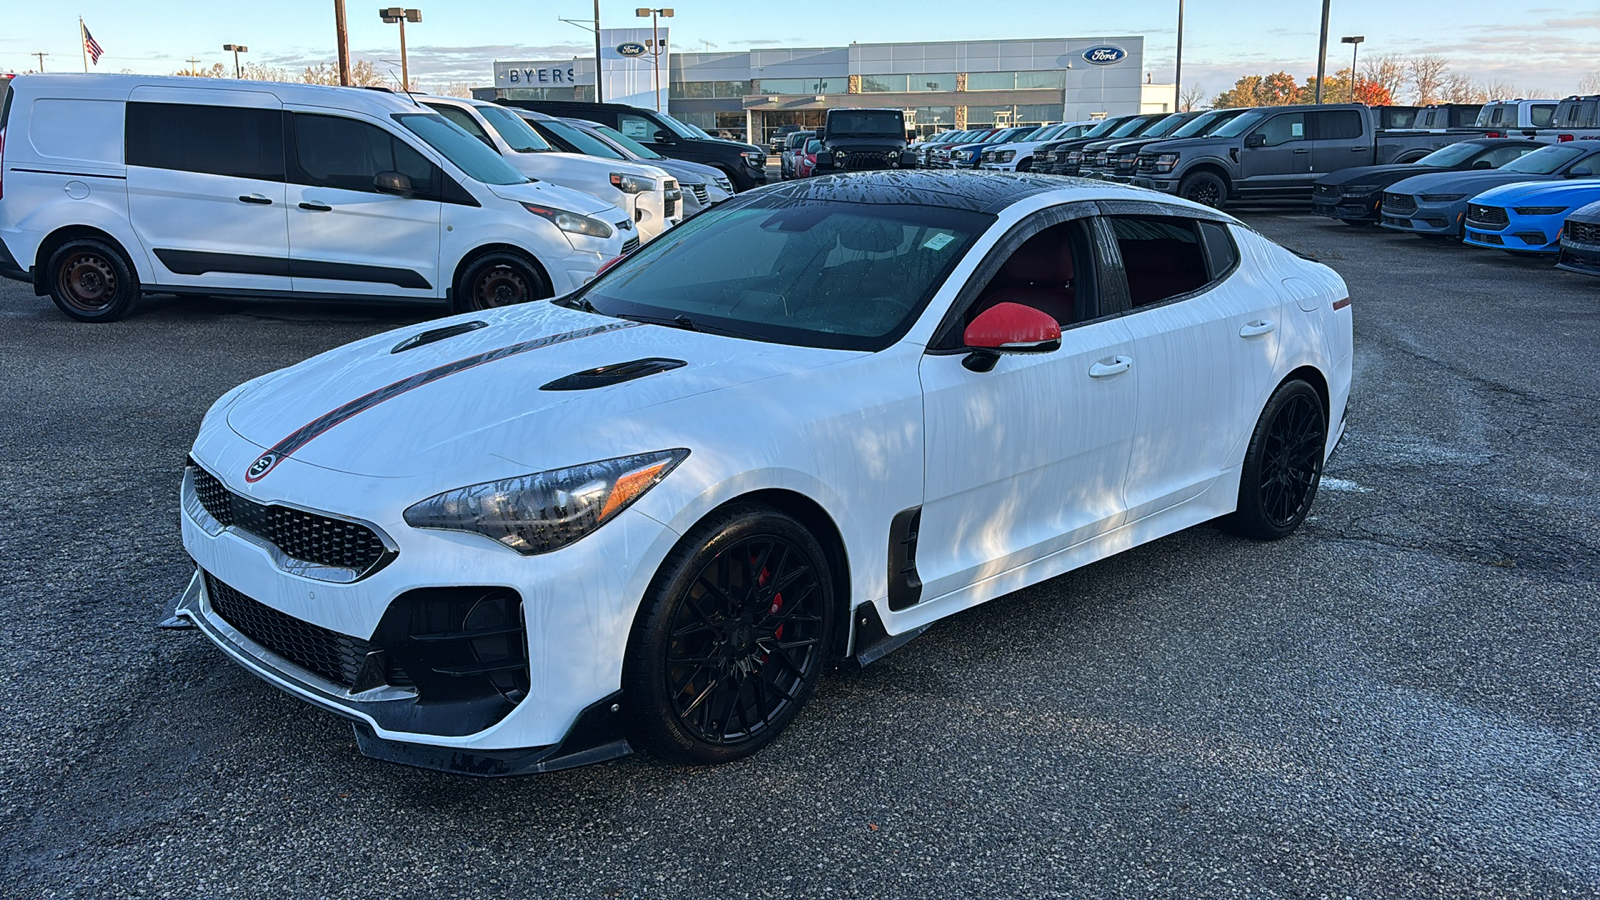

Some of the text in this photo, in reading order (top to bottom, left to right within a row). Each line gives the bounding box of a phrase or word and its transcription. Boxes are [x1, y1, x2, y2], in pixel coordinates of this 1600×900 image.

[622, 45, 640, 54] Ford
[1091, 49, 1118, 61] Ford
[510, 68, 574, 83] BYERS
